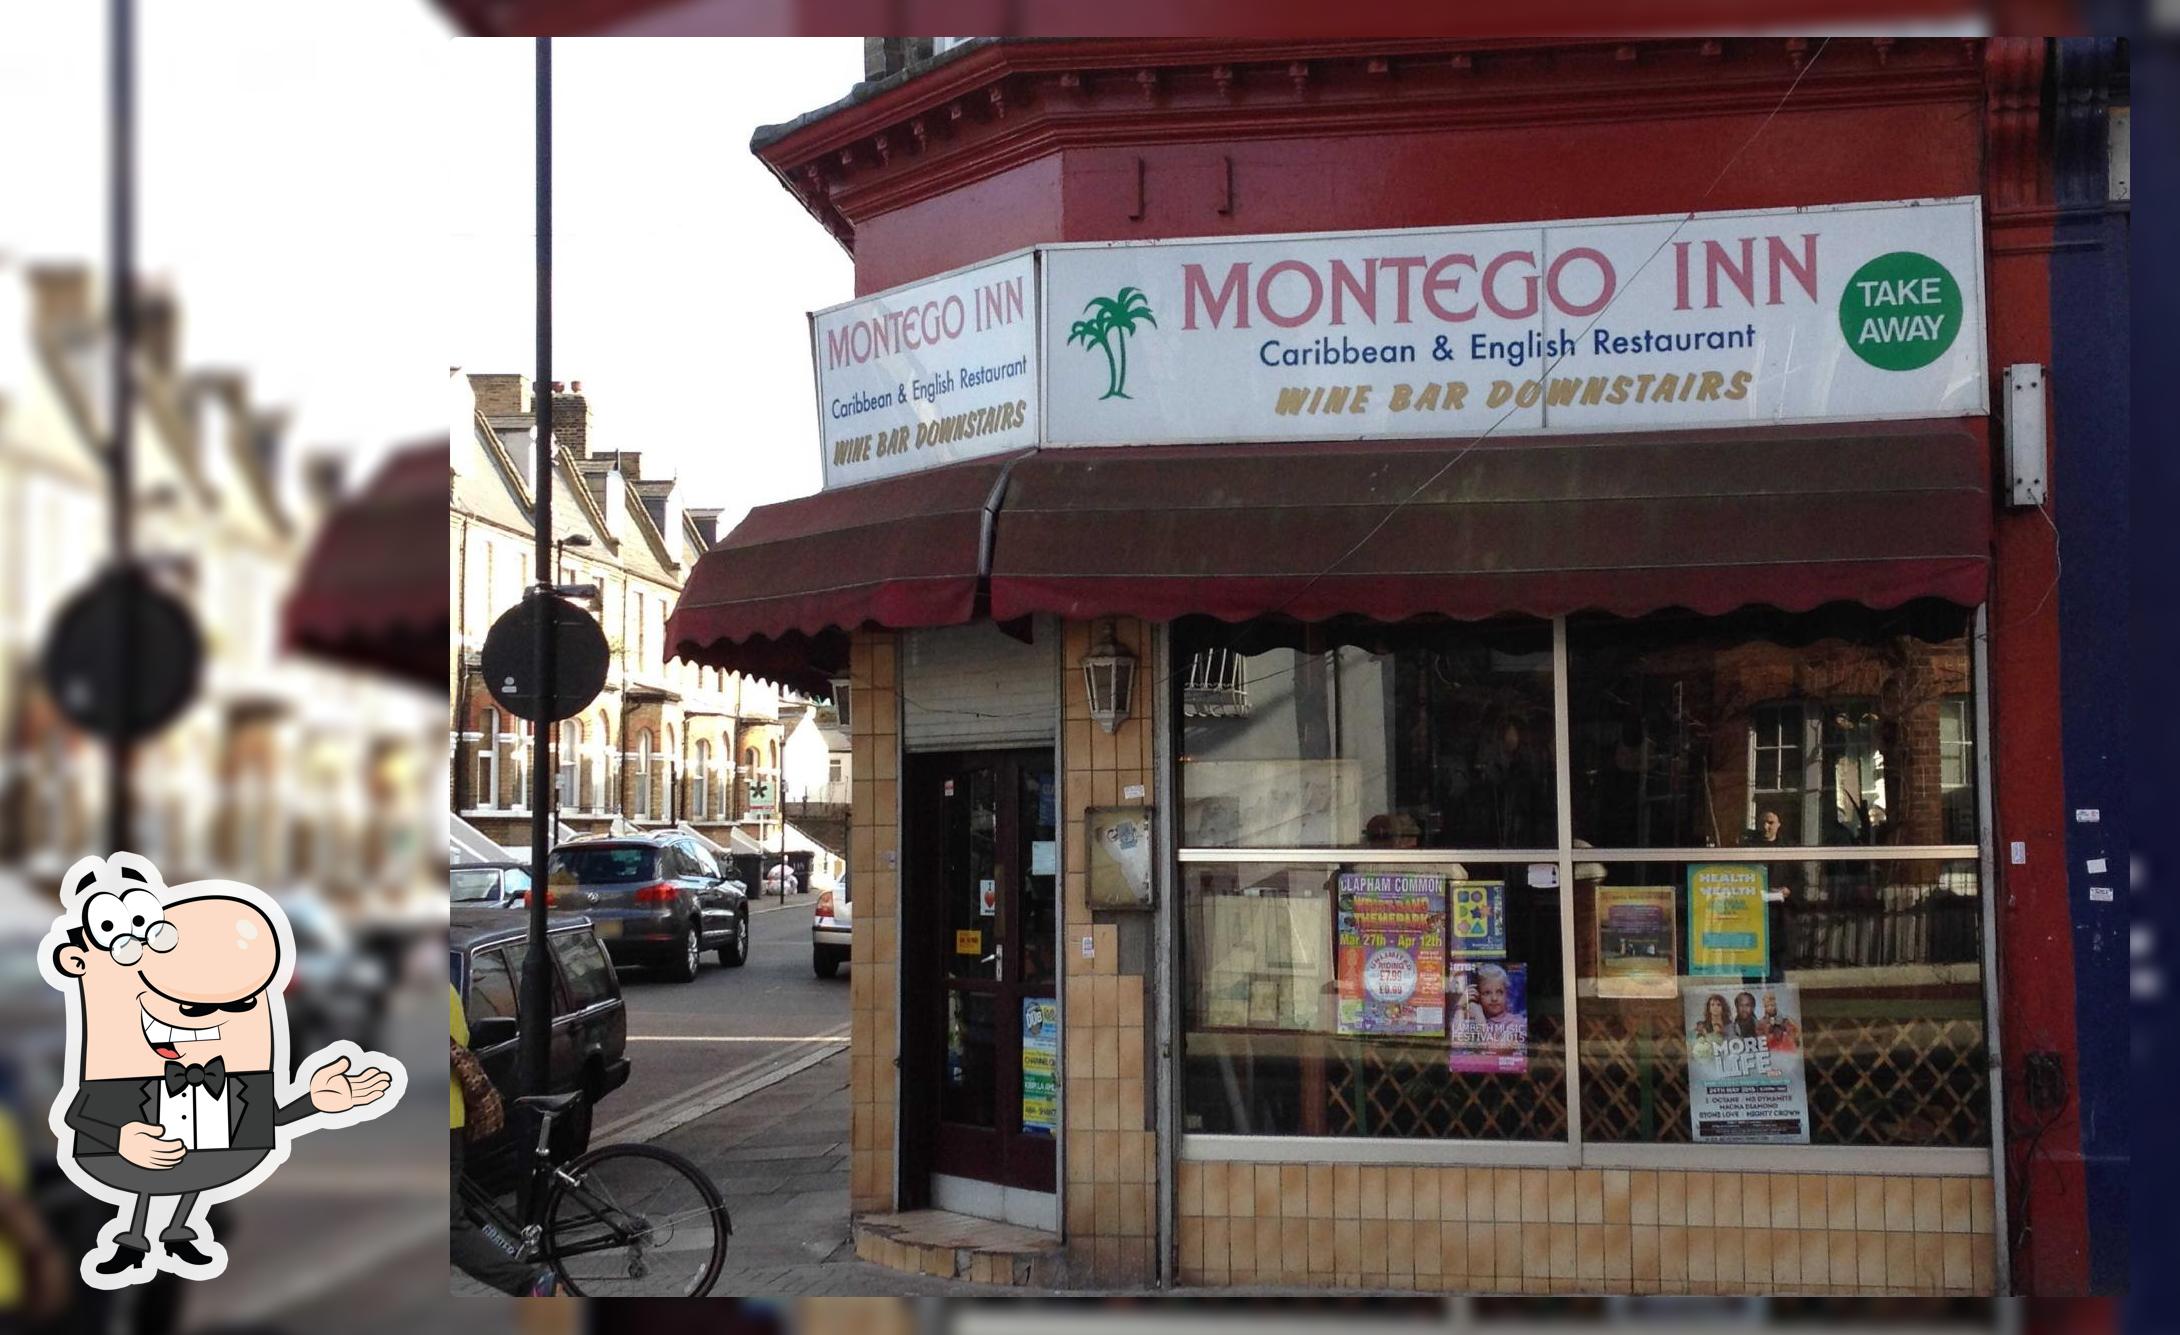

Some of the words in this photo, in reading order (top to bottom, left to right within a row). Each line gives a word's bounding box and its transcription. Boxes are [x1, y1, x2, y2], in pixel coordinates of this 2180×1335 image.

[1181, 247, 1616, 331] MONTEGO
[1673, 233, 1820, 311] INN
[1857, 277, 1942, 306] TAKE
[828, 294, 964, 370] MONTEGO
[975, 276, 1025, 333] INN
[1858, 314, 1946, 344] AWAY
[1260, 338, 1415, 367] Caribbean
[1432, 336, 1454, 362] &
[1471, 329, 1576, 367] English
[1593, 324, 1756, 355] Restaurant
[832, 390, 894, 419] Caribbean
[898, 384, 908, 403] &
[912, 371, 955, 403] English
[960, 357, 1028, 390] Restaurant
[1275, 385, 1373, 416] WINE
[1388, 380, 1469, 412] BAR
[1486, 370, 1755, 410] DOWNSTAIRS
[833, 433, 871, 467] WINE
[876, 425, 909, 457] BAR
[916, 400, 1027, 448] DOWNSTAIRS
[1340, 877, 1391, 892] CLAPHAM
[1394, 877, 1442, 892] COMMON
[1699, 873, 1756, 883] HEALTH
[1363, 933, 1386, 946] 27th
[1398, 934, 1416, 949] Apr
[1421, 933, 1442, 946] 12th
[1452, 1022, 1494, 1033] LAMBETH
[1495, 1023, 1525, 1034] MUSIC
[1452, 1031, 1498, 1042] FESTIVAL
[1712, 1035, 1769, 1056] MORE
[1715, 1051, 1772, 1078] LIFE
